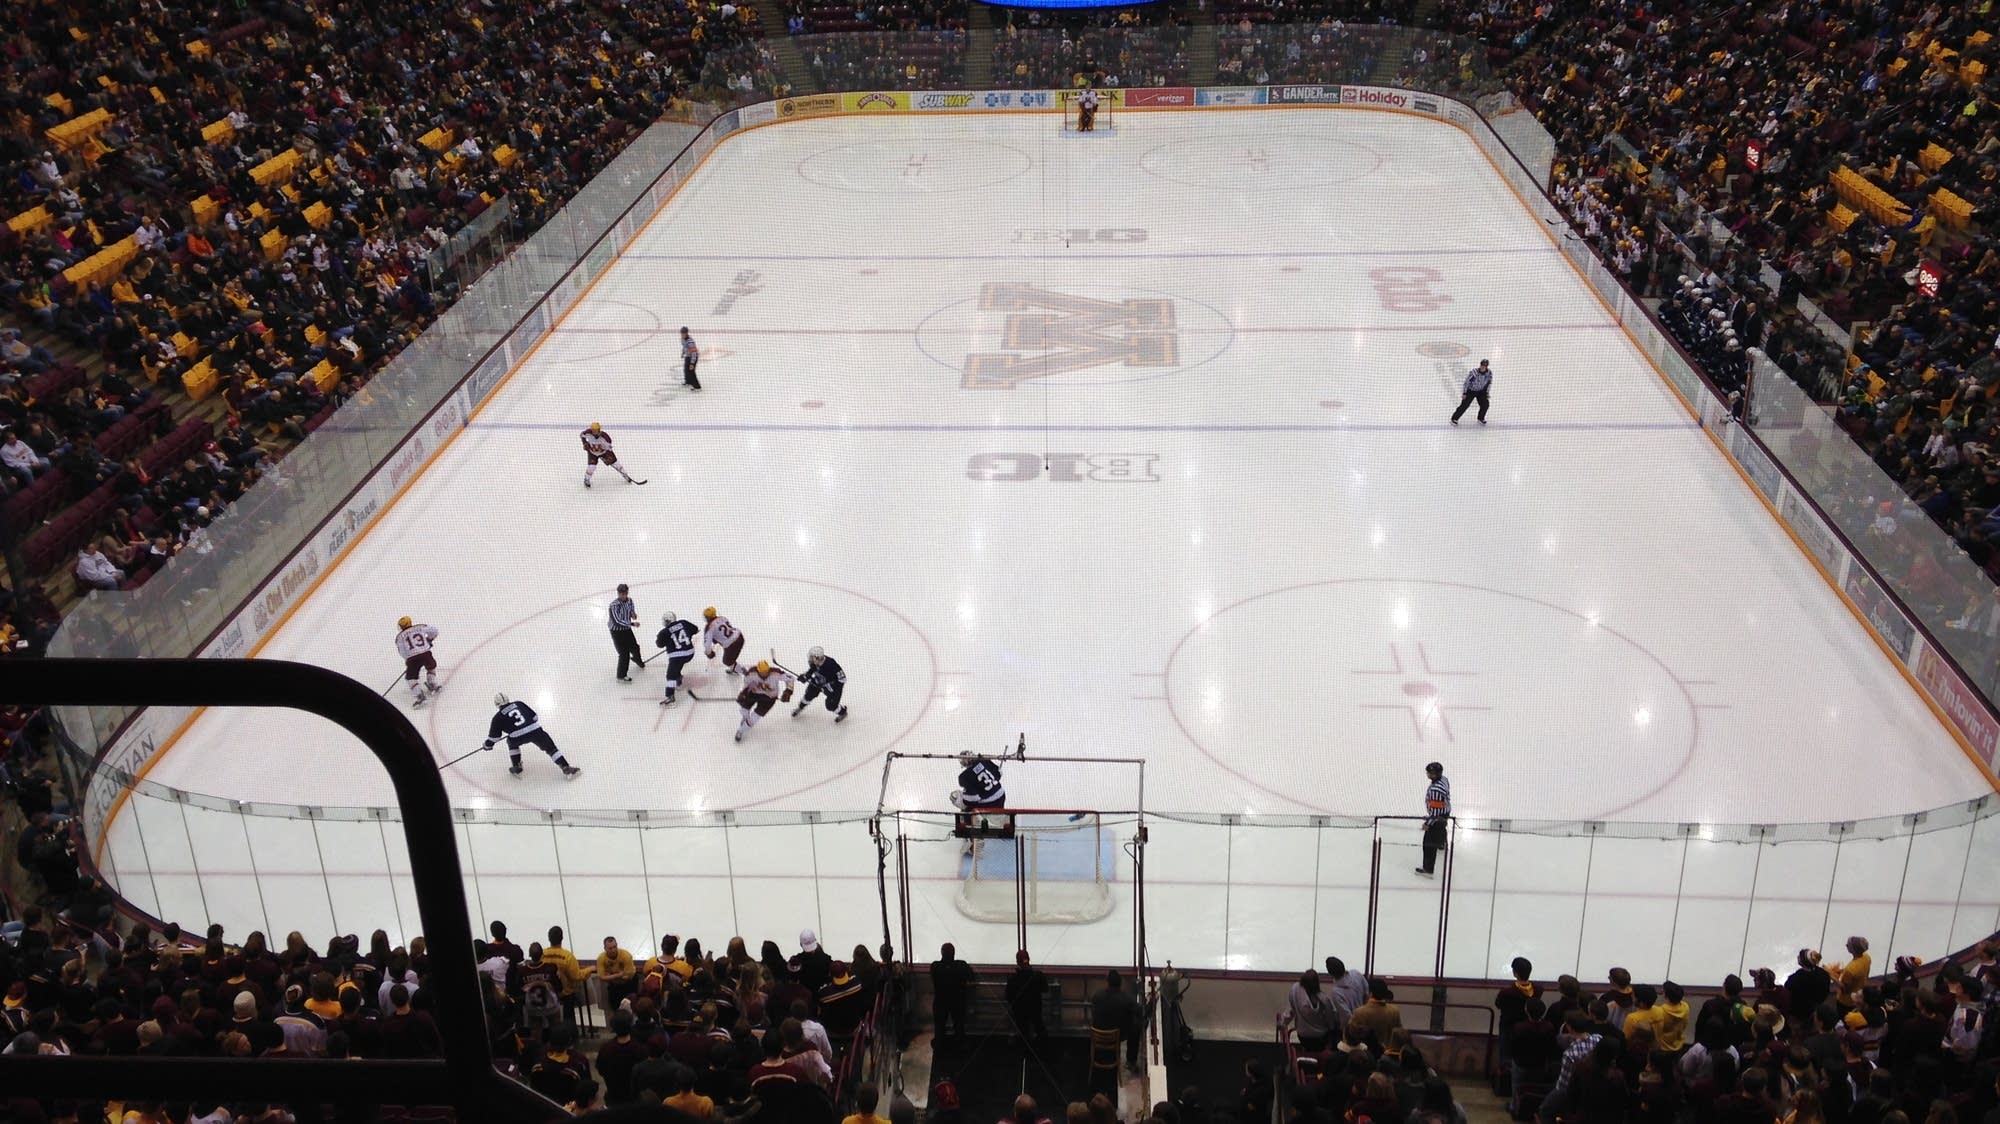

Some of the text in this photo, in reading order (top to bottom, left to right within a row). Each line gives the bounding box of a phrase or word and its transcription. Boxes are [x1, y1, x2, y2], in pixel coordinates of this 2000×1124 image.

[920, 93, 974, 108] SUBWAY
[1157, 95, 1185, 103] verizon
[1283, 87, 1323, 99] GANDER
[1360, 90, 1407, 107] Holiday
[405, 633, 425, 650] 13
[670, 629, 690, 650] 14
[508, 709, 526, 727] 3
